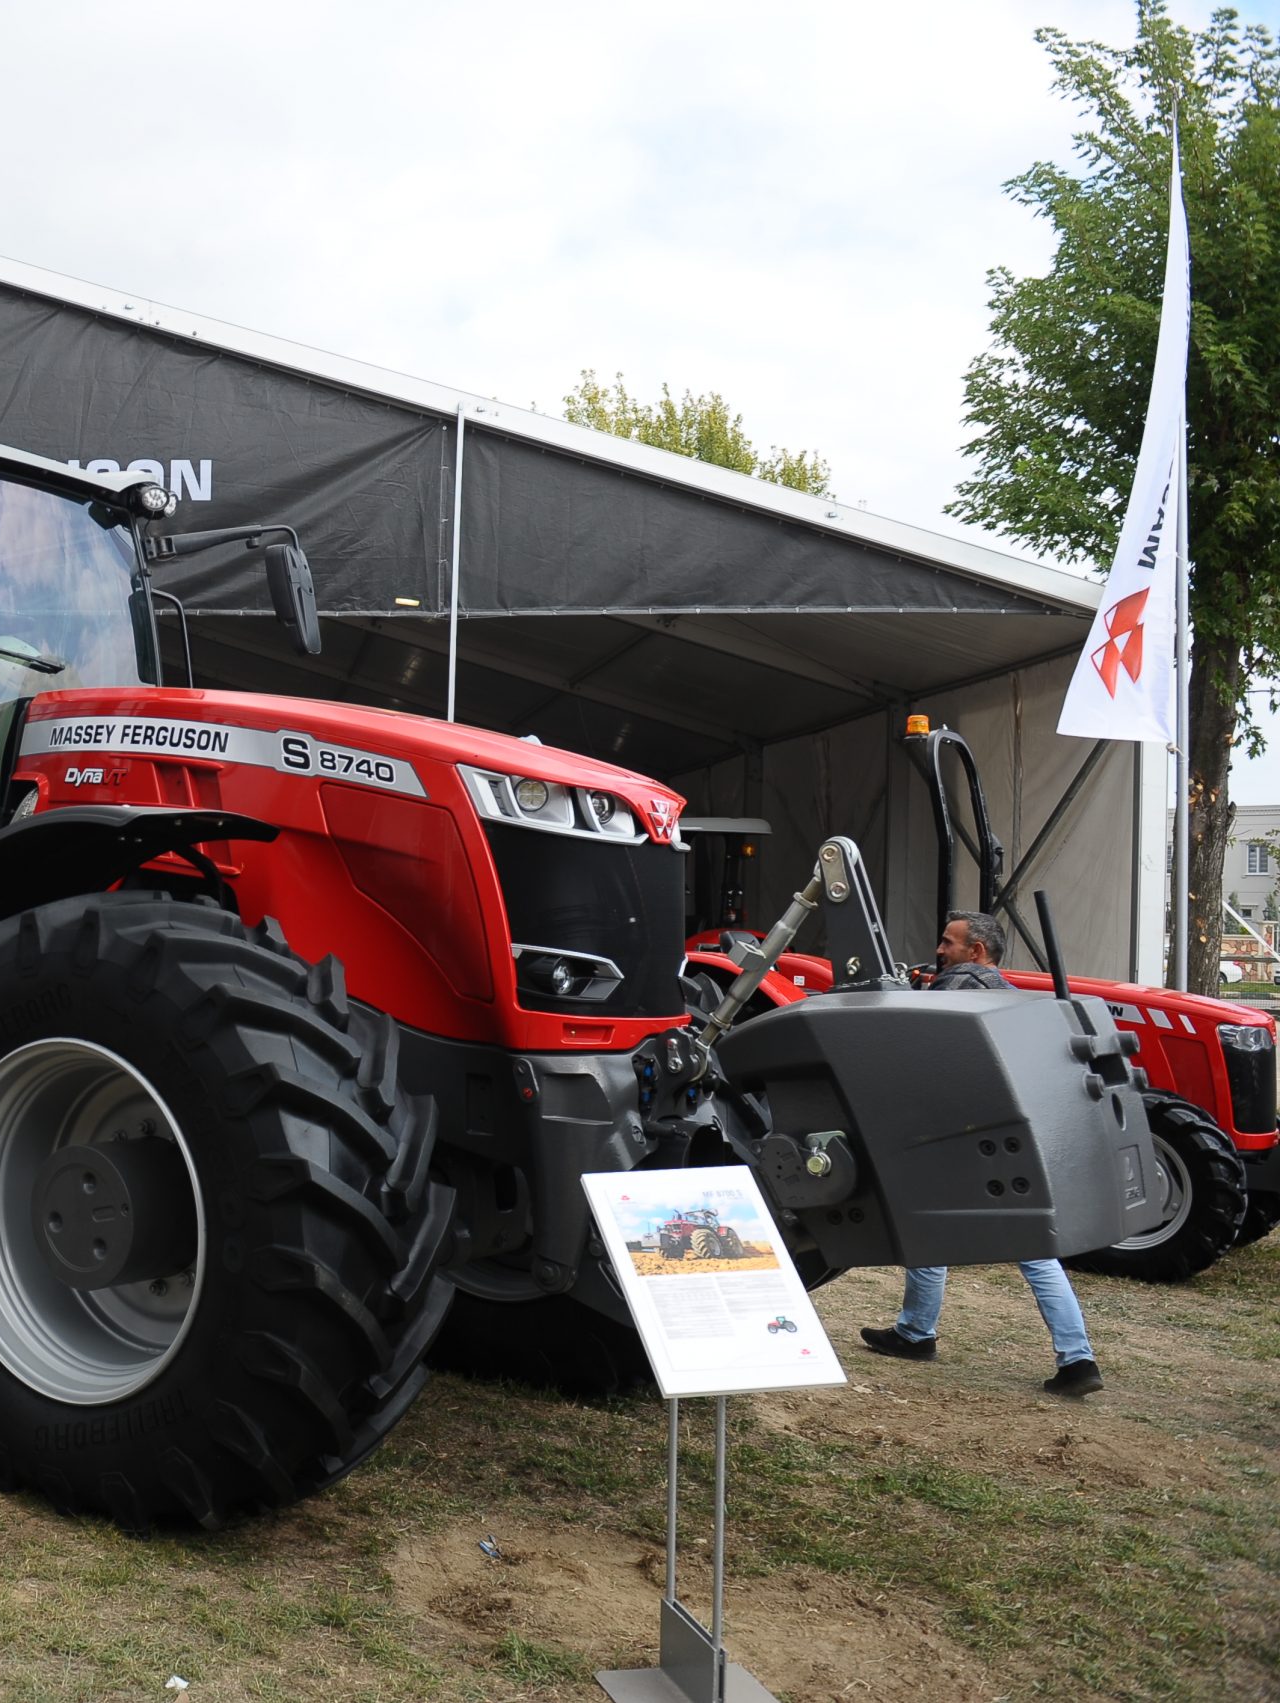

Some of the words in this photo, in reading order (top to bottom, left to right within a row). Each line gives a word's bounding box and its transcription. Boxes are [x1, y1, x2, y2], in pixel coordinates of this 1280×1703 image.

[49, 724, 116, 746] MASSEY
[120, 724, 229, 752] FERGUSON
[283, 737, 311, 770] S
[319, 750, 395, 783] 8740
